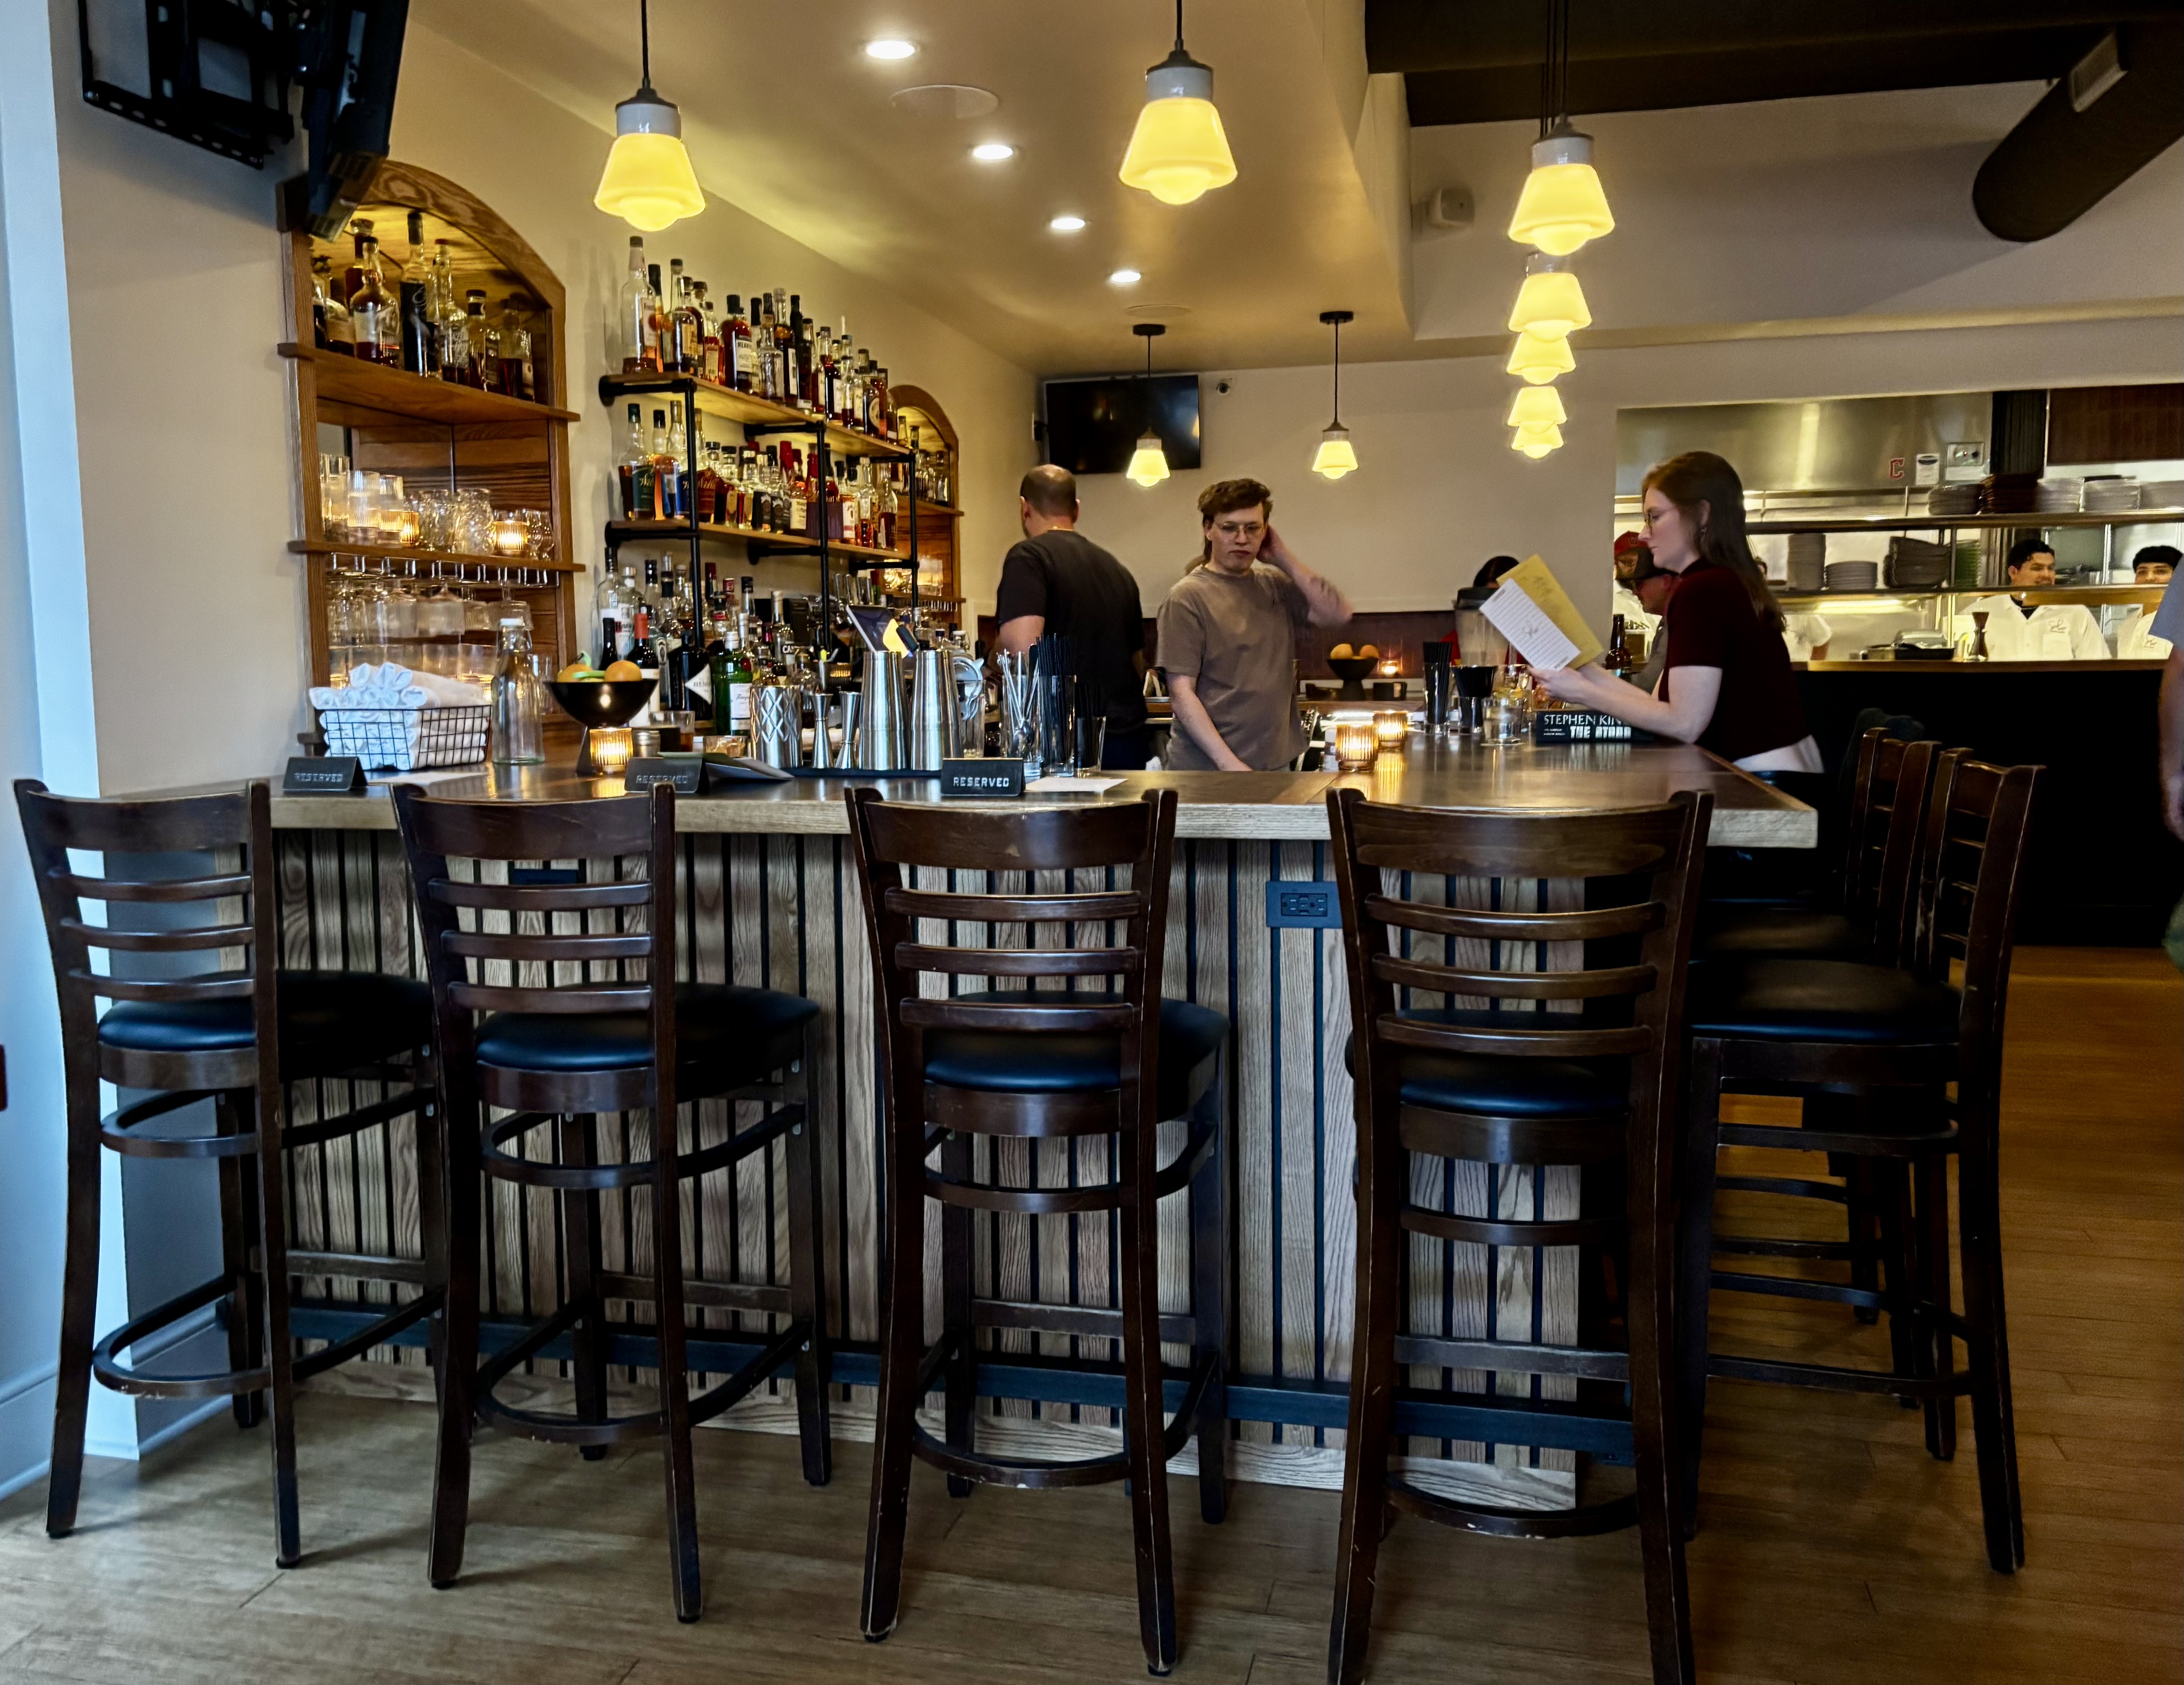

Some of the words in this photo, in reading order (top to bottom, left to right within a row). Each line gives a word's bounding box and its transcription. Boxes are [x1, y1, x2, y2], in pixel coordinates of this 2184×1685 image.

[1544, 714, 1596, 725] STEPHEN
[1570, 726, 1591, 739] THE
[953, 777, 1009, 788] RESERVED
